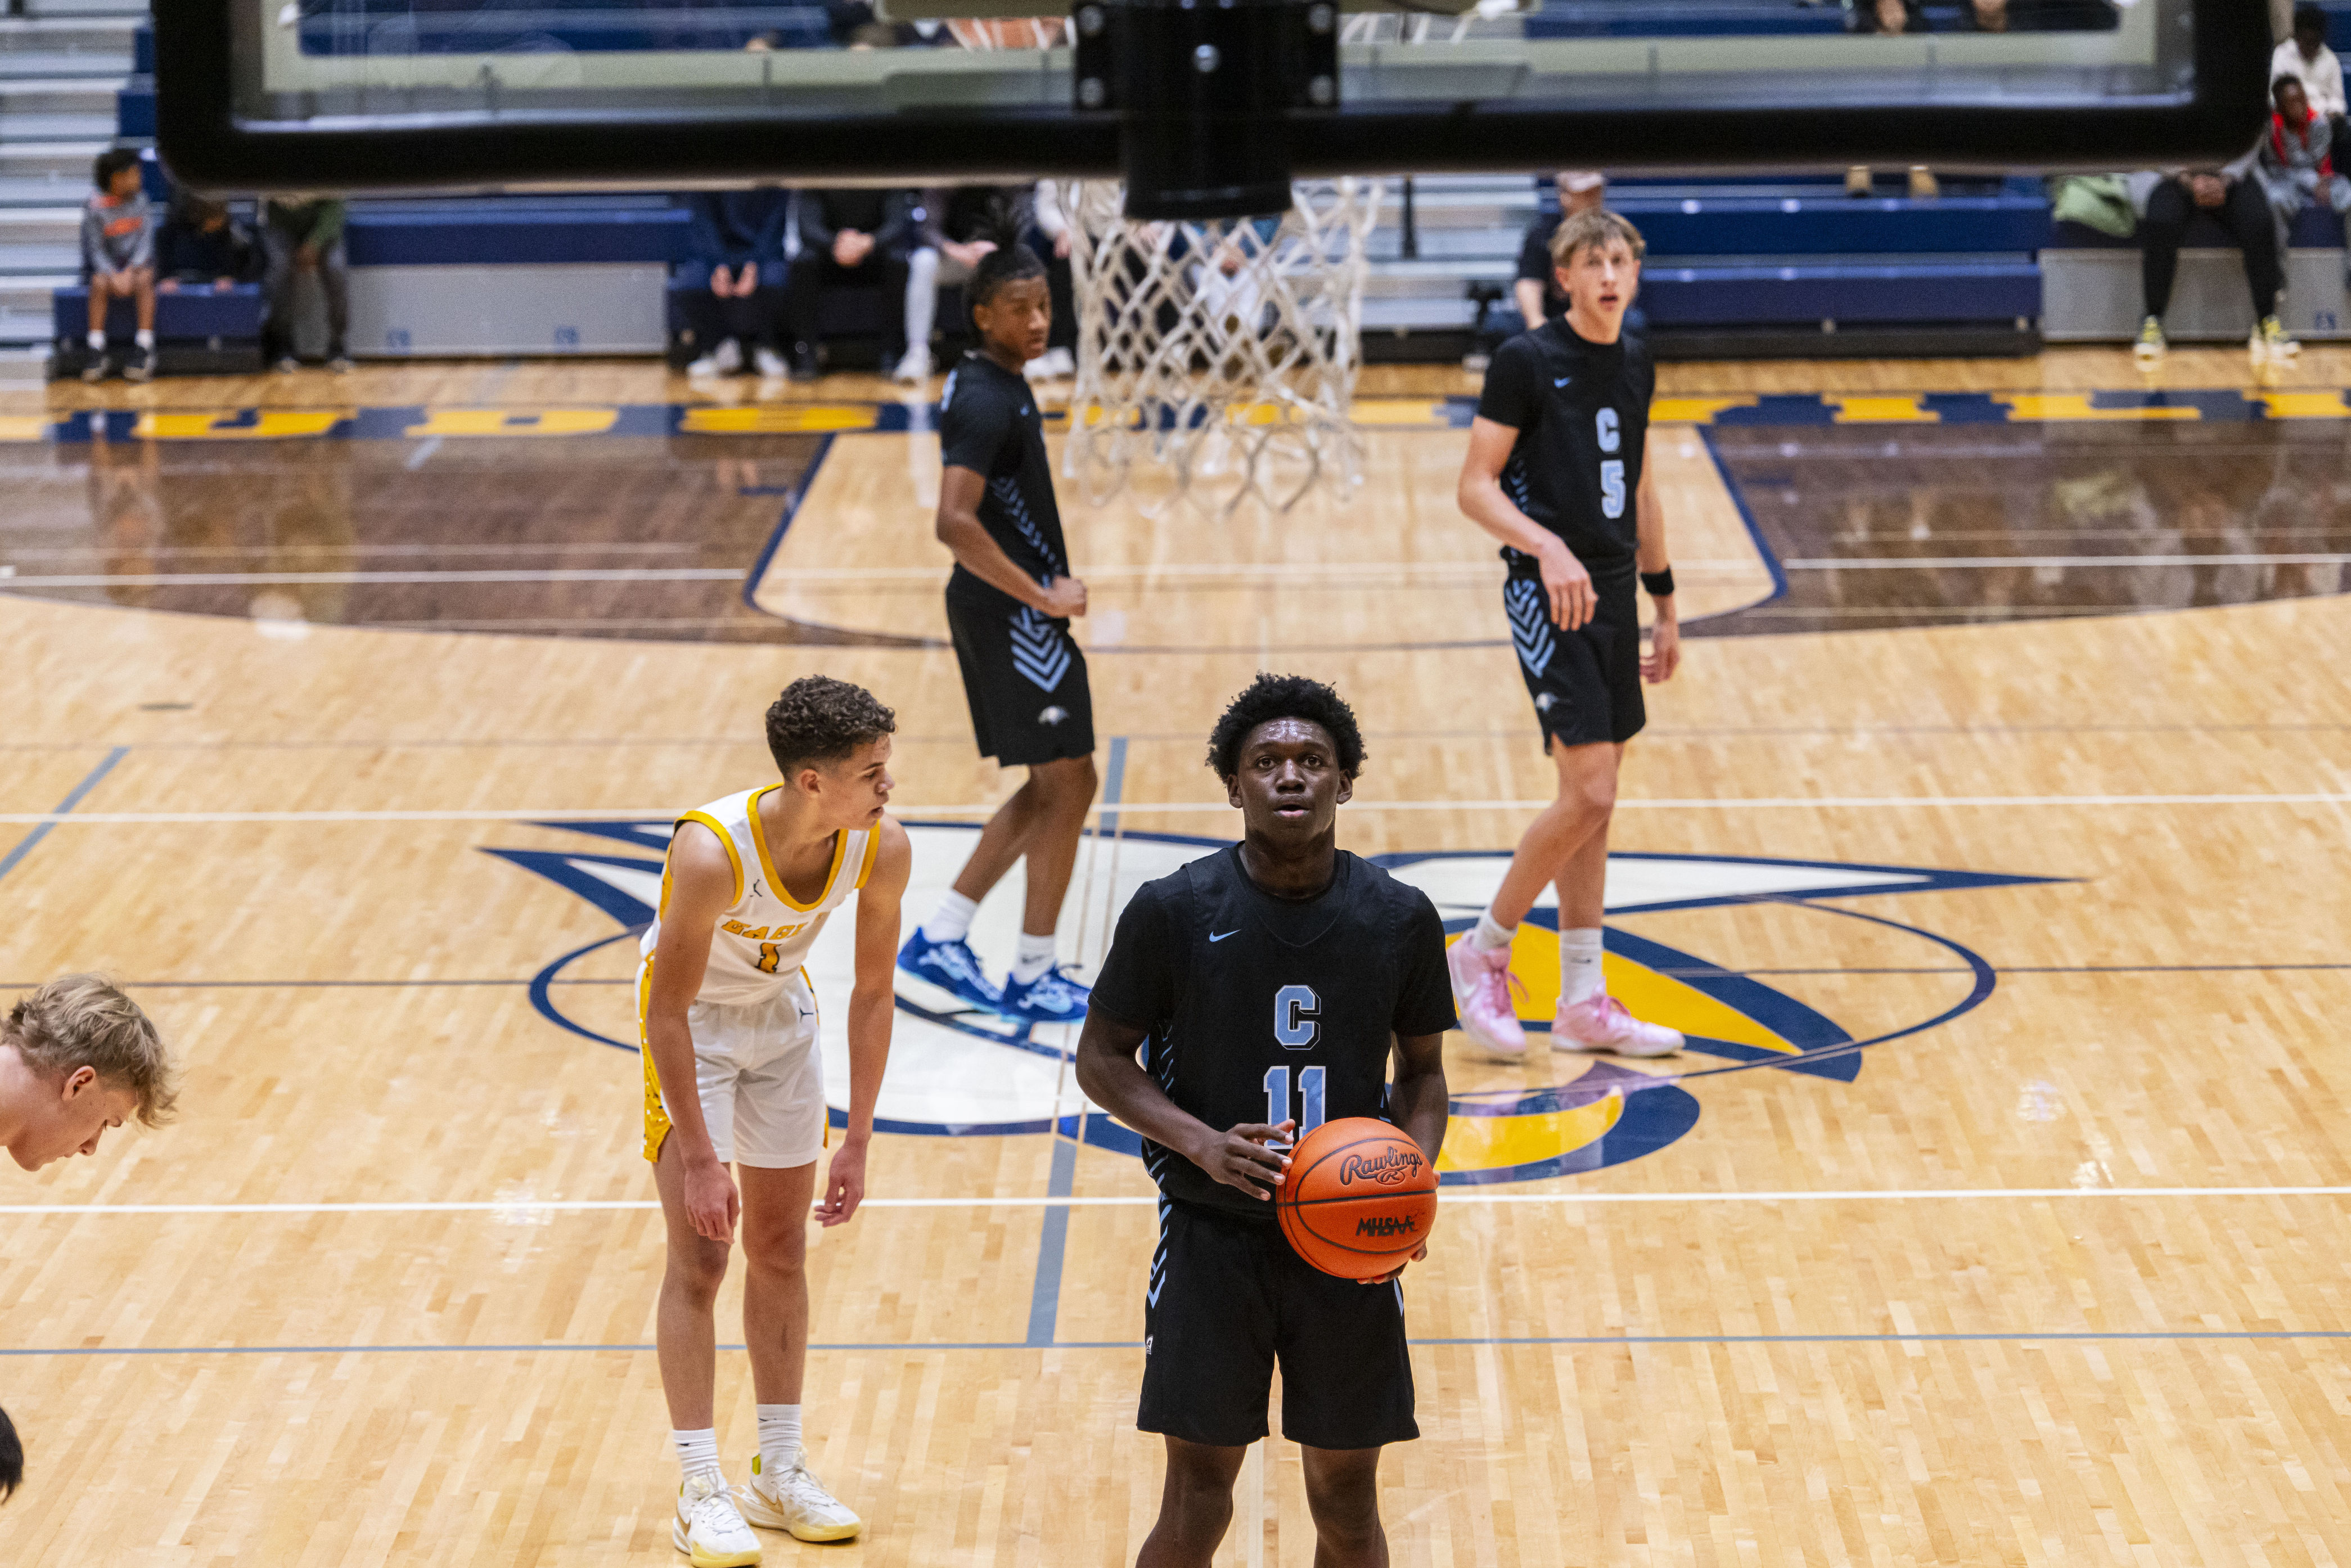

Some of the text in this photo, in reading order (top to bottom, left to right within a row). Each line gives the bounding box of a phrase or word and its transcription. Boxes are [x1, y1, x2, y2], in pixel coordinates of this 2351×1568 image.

[1595, 407, 1621, 454] C
[1600, 458, 1627, 519] 5
[755, 942, 782, 974] 1
[1274, 985, 1321, 1050] C
[1263, 1065, 1326, 1149] 11
[1340, 1146, 1423, 1186] Rawlings
